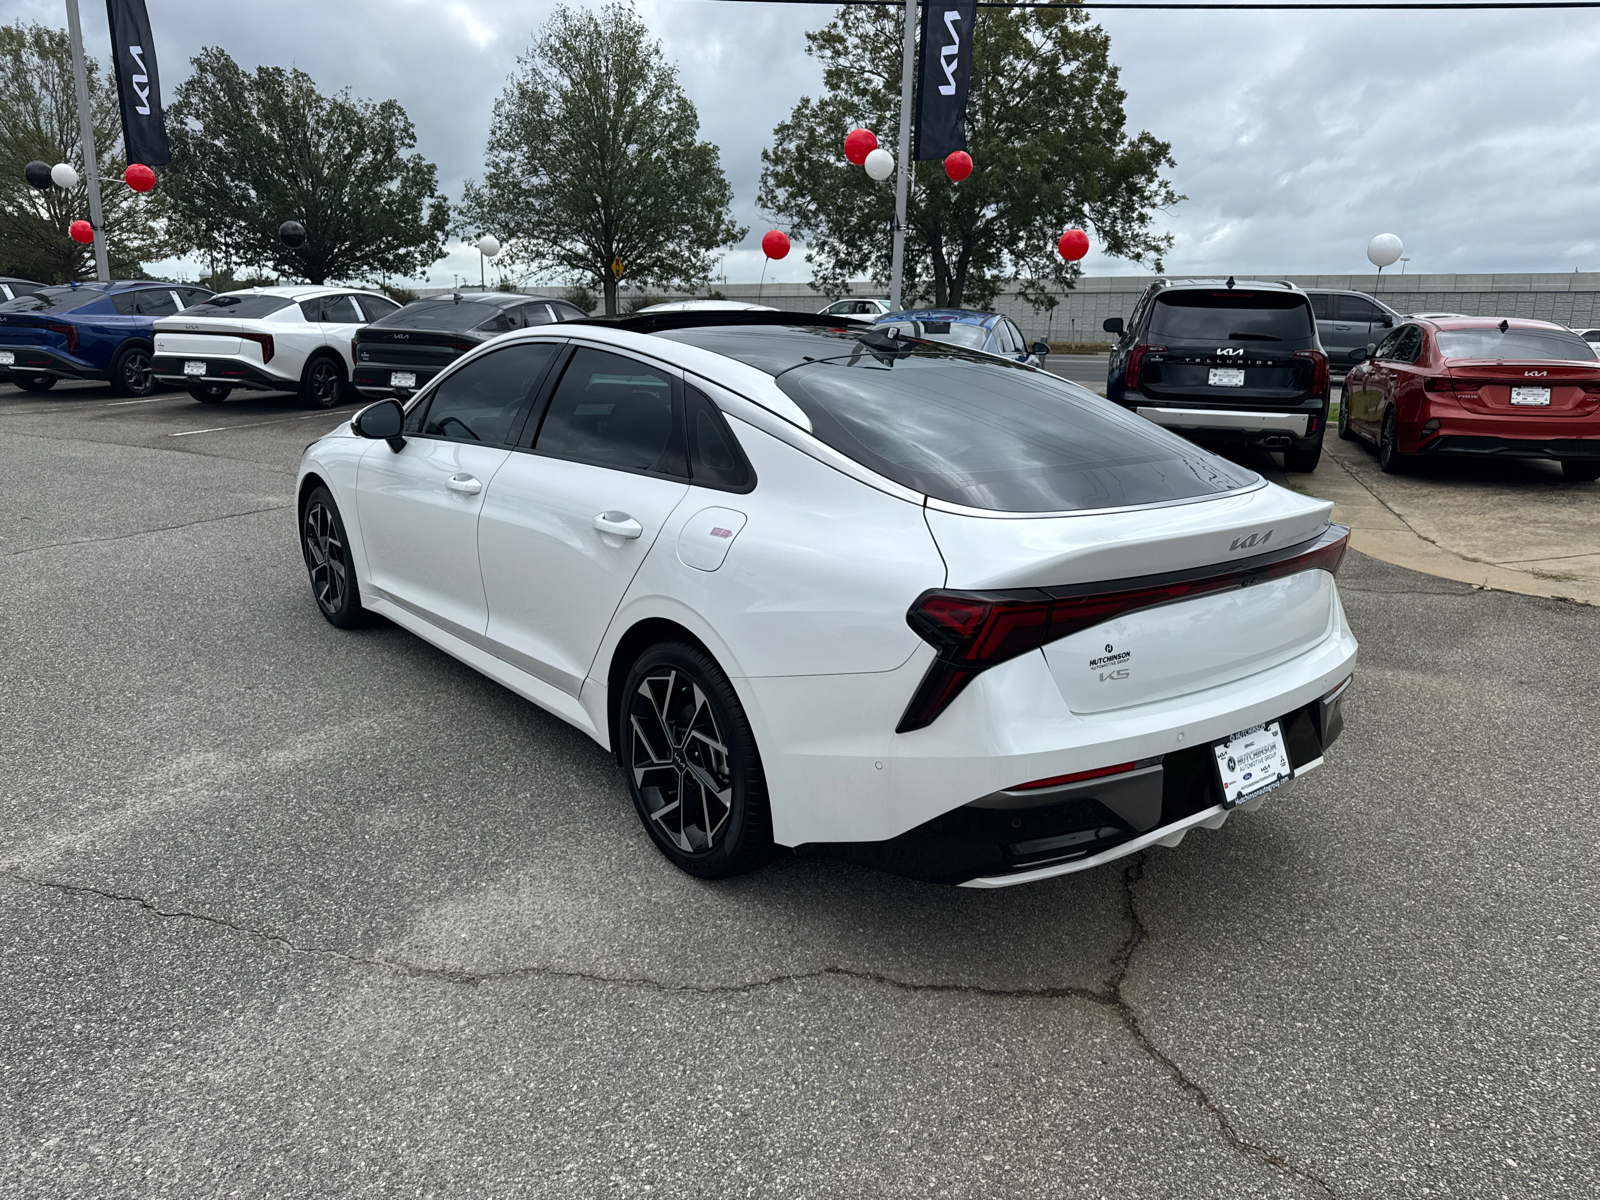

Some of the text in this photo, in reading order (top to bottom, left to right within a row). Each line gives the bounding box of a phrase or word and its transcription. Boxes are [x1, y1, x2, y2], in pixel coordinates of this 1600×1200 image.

[937, 10, 962, 96] KIA
[129, 45, 151, 115] KIA
[1216, 348, 1244, 356] KIA
[1229, 528, 1274, 551] KIA
[1089, 650, 1131, 666] HUTCHINSON
[1091, 660, 1116, 670] AUTOMOTIVE
[1099, 668, 1129, 682] K5
[1218, 751, 1228, 759] KIA
[1237, 741, 1277, 766] HUTCHINSON
[1240, 757, 1264, 773] AUTOMOTIVE
[1264, 751, 1277, 762] GROUP
[1261, 764, 1270, 772] KIA
